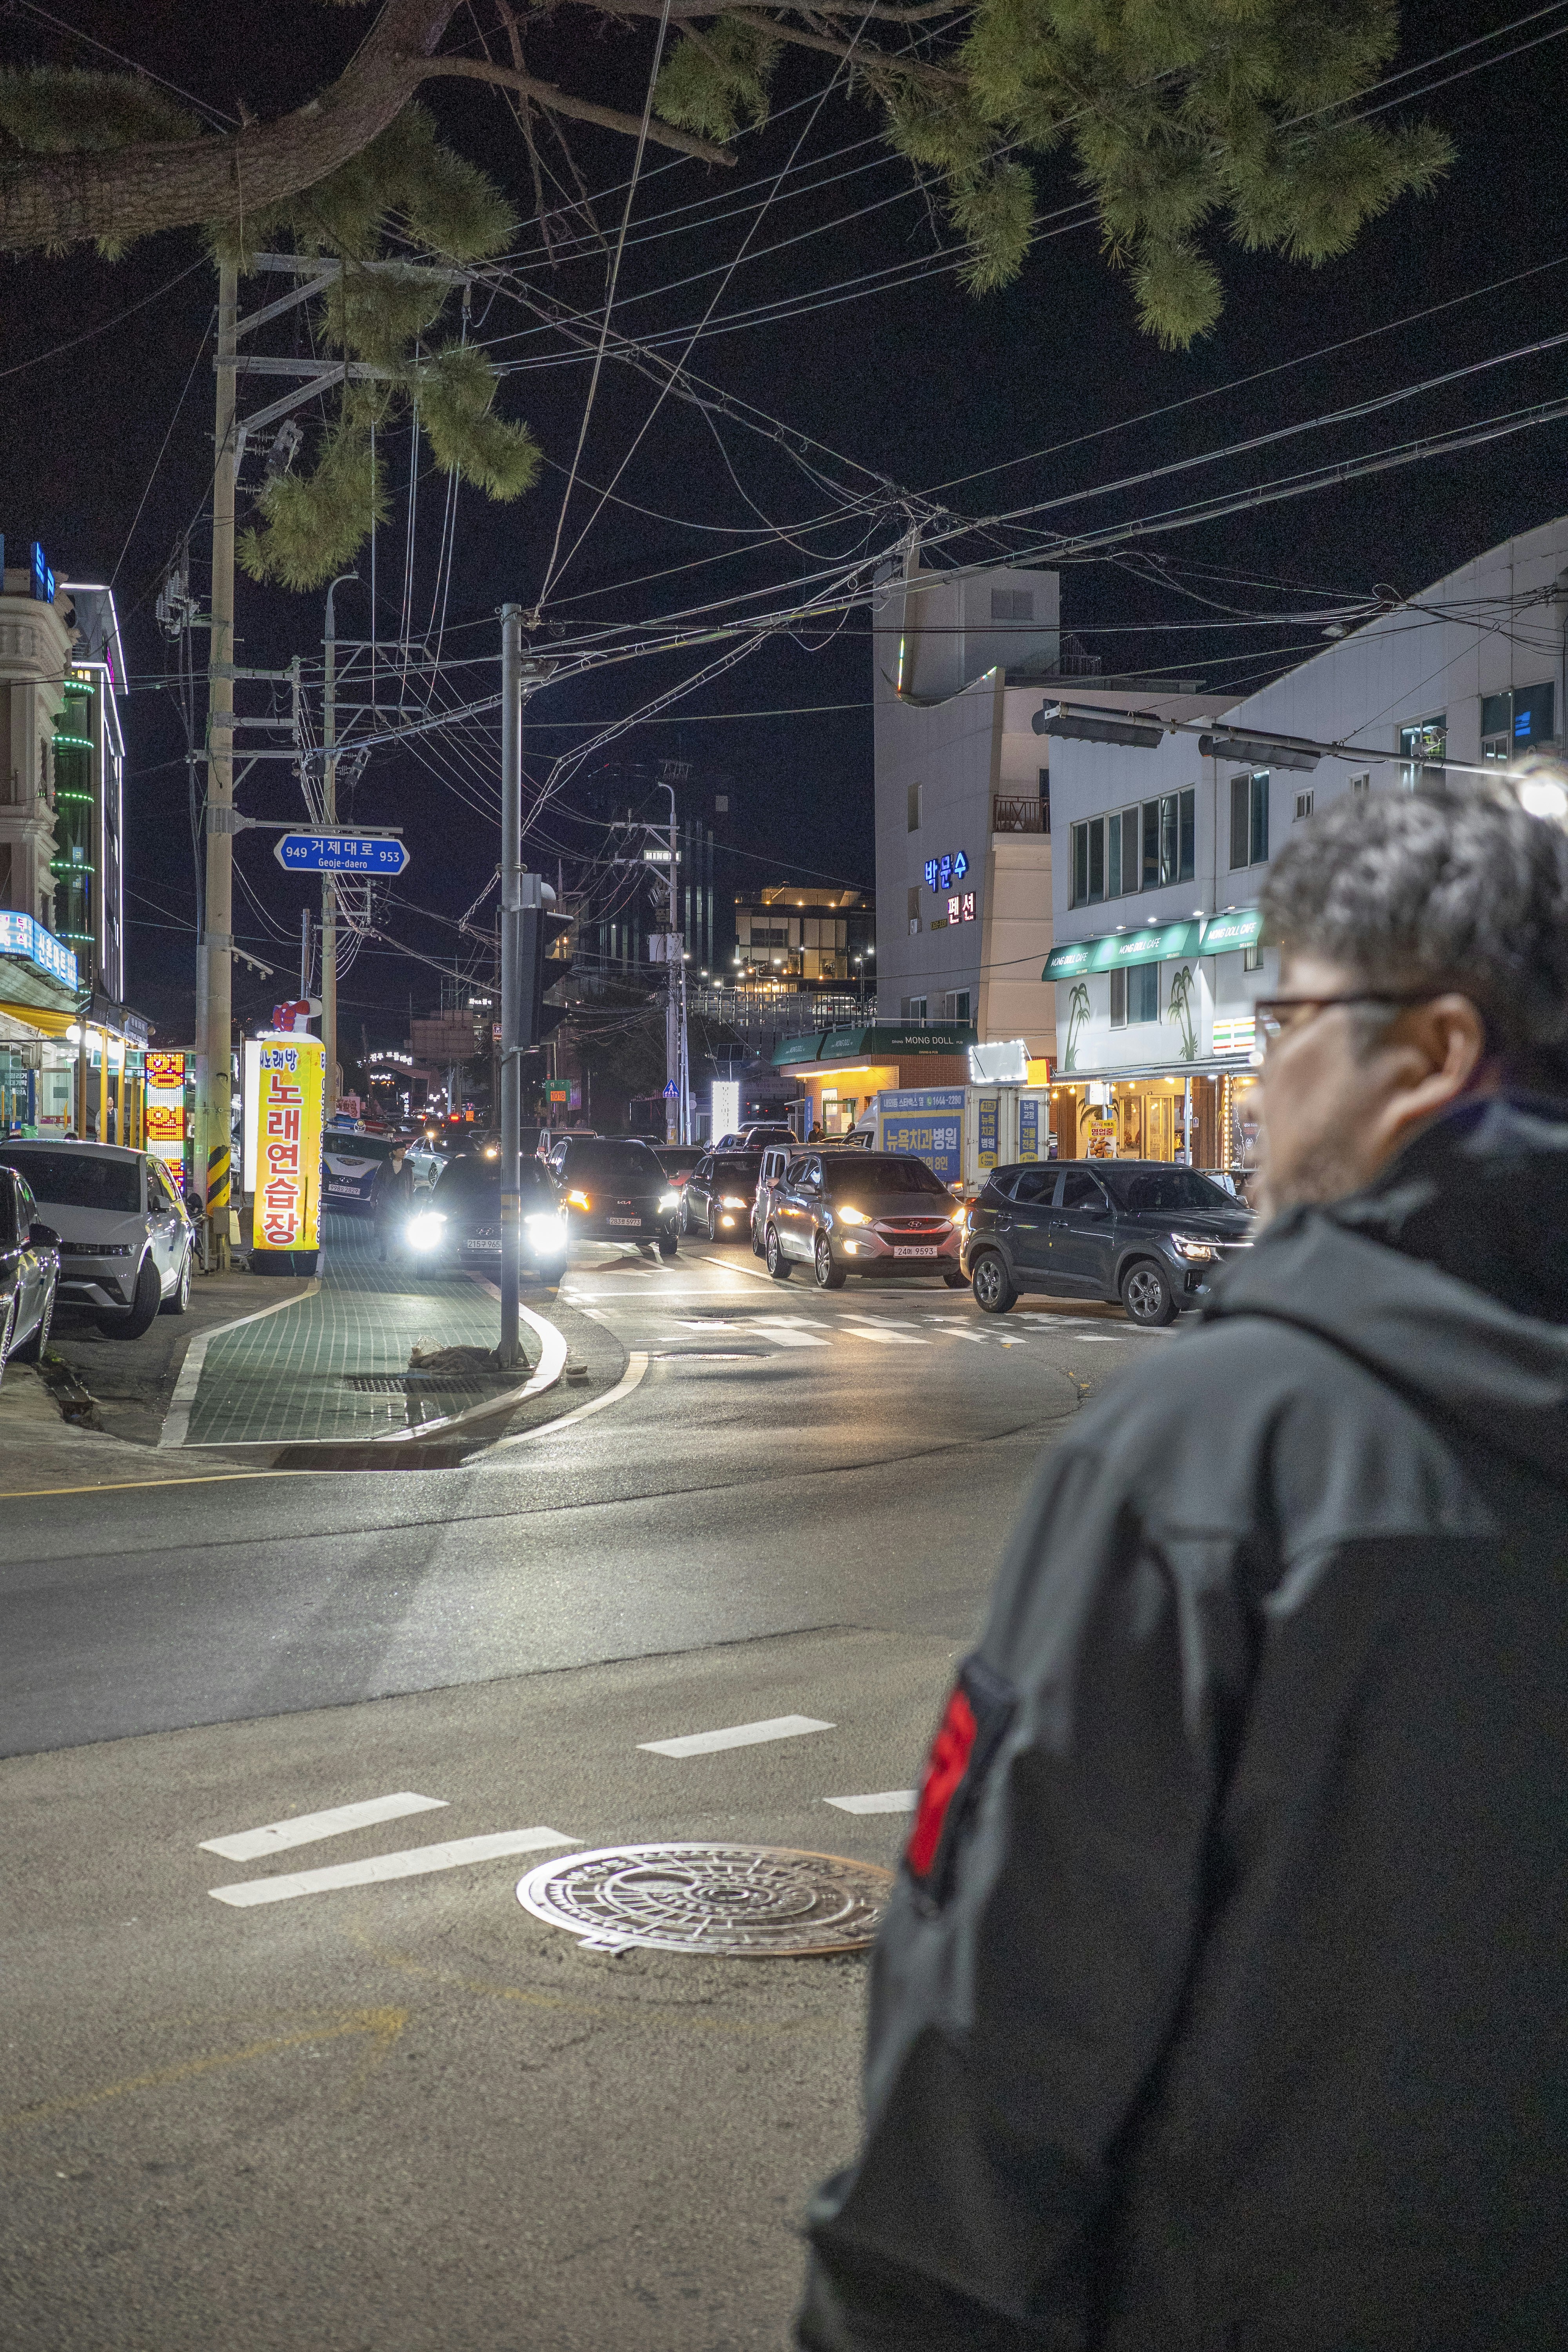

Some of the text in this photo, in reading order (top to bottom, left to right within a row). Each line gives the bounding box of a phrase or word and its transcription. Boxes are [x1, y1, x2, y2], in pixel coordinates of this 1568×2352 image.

[286, 840, 399, 862] 949 거제대로 953
[318, 858, 367, 869] Geoje-daero
[925, 852, 966, 893] 박문수
[948, 893, 974, 925] 펜션
[1208, 922, 1257, 940] MONG DOLL CAFE
[1118, 937, 1161, 955] MONG DOLL CAFE
[1051, 952, 1088, 967] MONG DOLL CAFE
[1024, 1102, 1034, 1111] 뉴욕
[981, 1114, 995, 1125] 뉴욕
[1024, 1111, 1034, 1120] 교정
[982, 1126, 995, 1136] 치과
[1022, 1128, 1036, 1138] 건물
[887, 1127, 957, 1151] 뉴욕치과병원
[981, 1138, 995, 1149] 병원
[264, 1075, 302, 1245] 노래연습장
[935, 1156, 948, 1171] 8인
